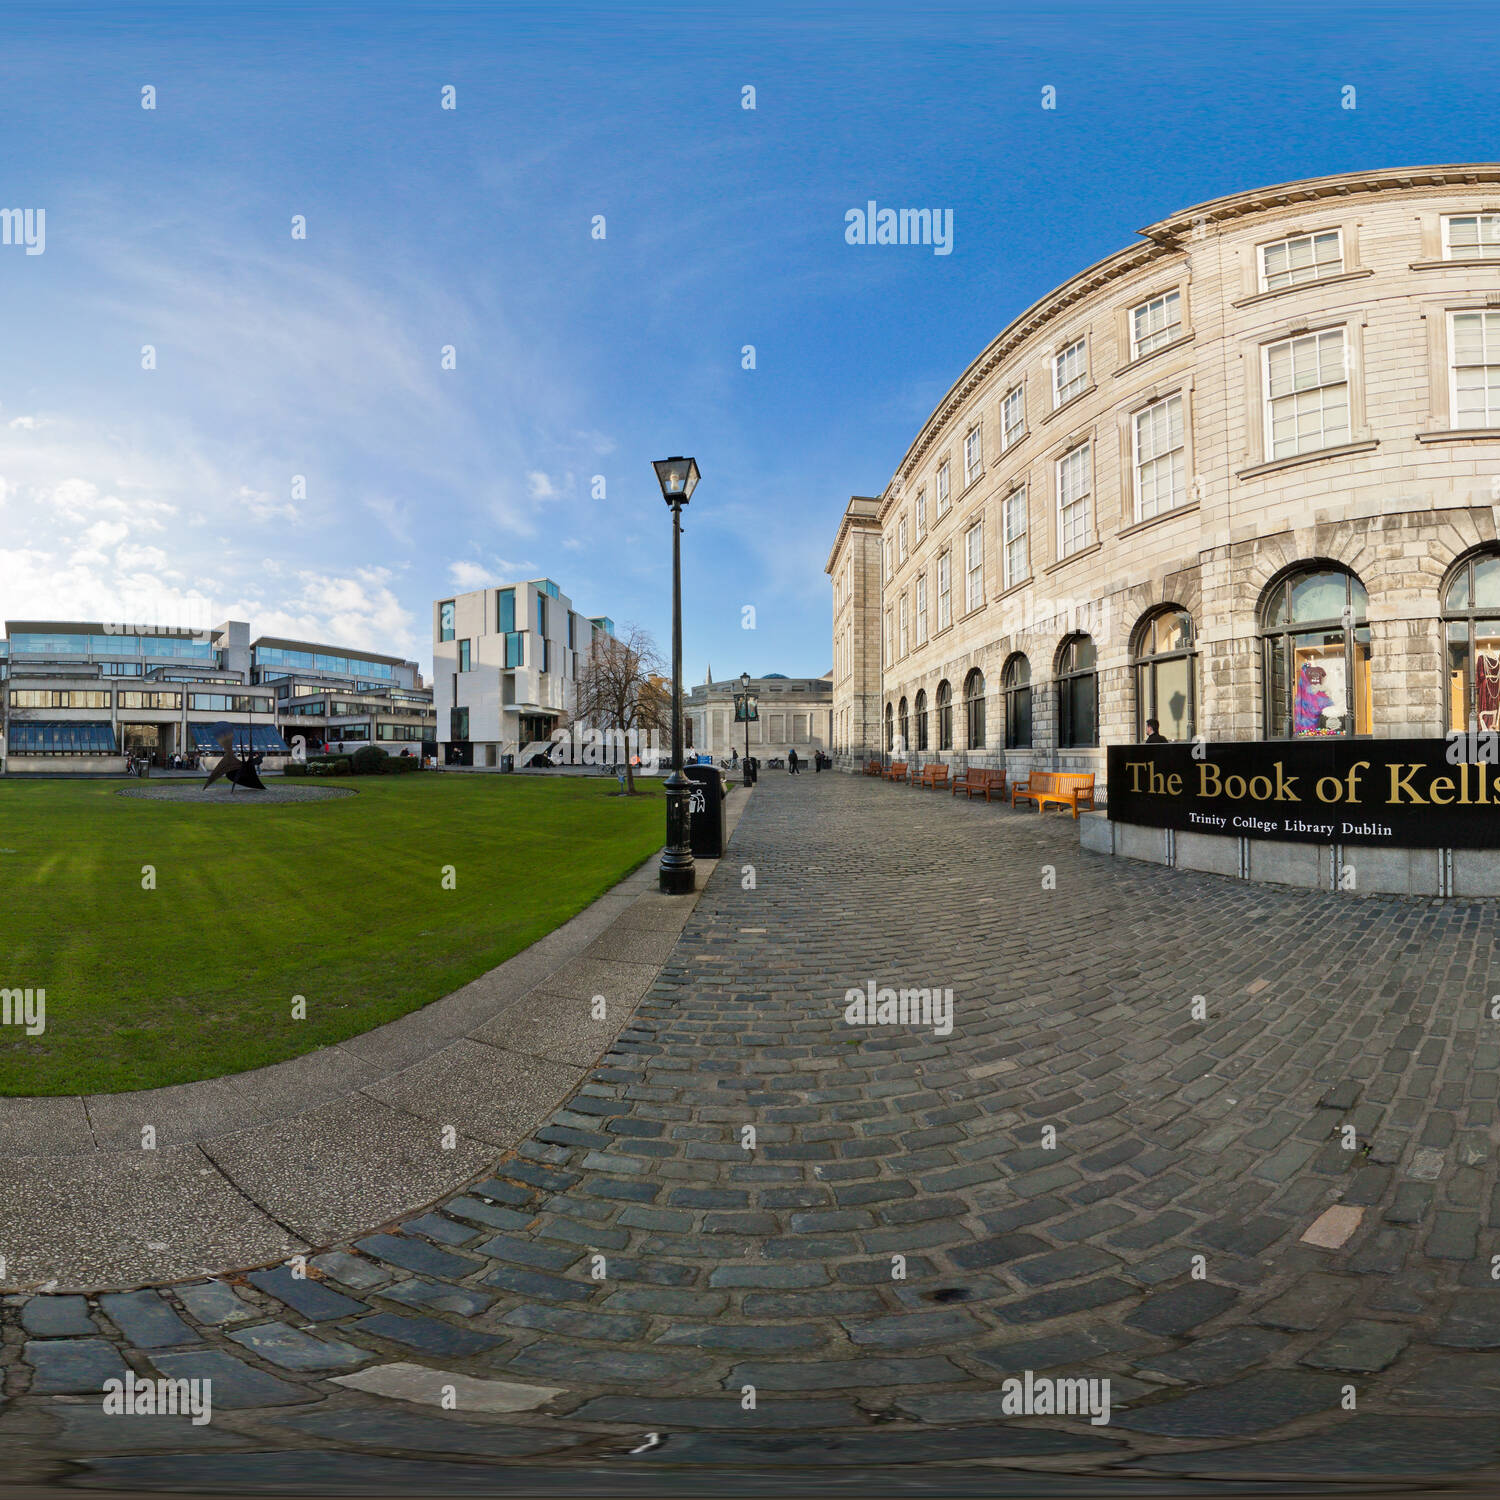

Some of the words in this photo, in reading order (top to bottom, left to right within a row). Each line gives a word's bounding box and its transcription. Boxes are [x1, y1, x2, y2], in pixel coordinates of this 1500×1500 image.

[1125, 761, 1183, 796] The
[1195, 761, 1302, 801] Book
[1315, 761, 1371, 803] of
[1189, 812, 1227, 828] Trinity
[1232, 816, 1278, 833] College
[1285, 819, 1335, 837] Library
[1341, 822, 1393, 837] Dublin
